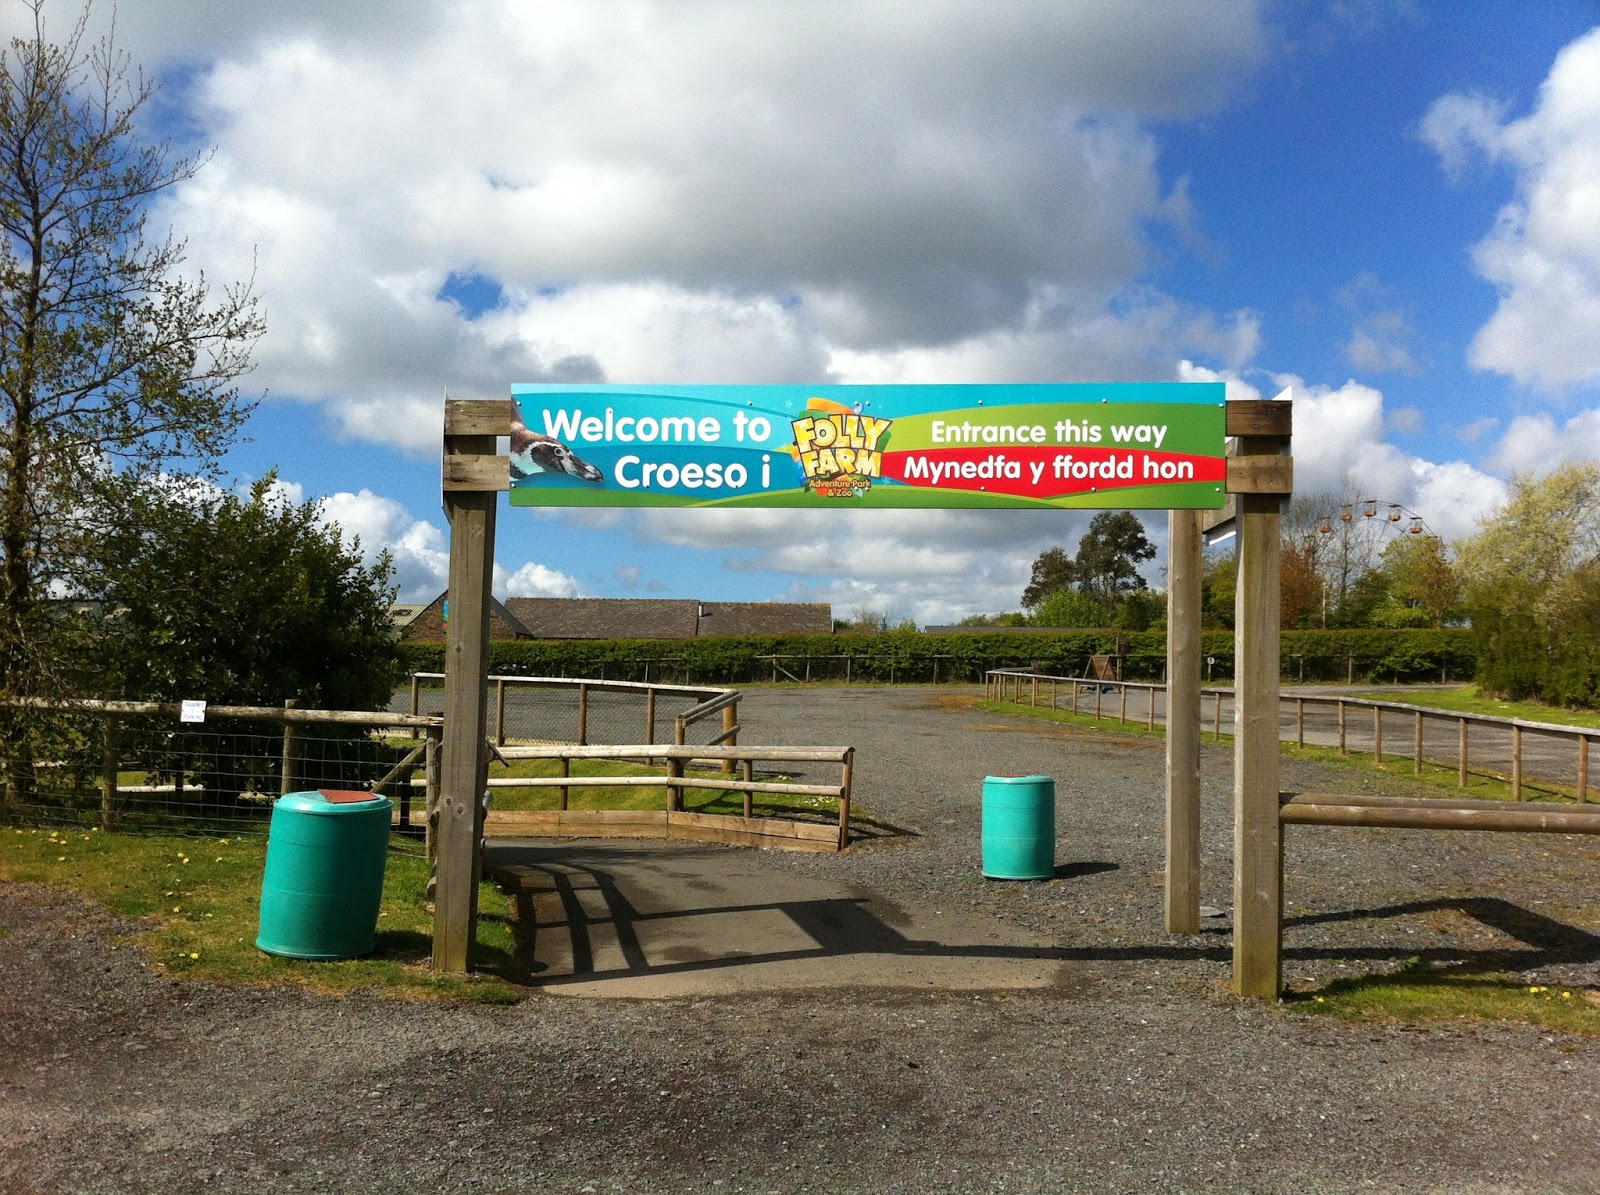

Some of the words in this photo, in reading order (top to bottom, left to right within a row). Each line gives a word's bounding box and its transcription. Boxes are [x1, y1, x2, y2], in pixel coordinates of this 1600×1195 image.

[542, 407, 721, 442] Welcome
[732, 410, 772, 442] to
[791, 413, 893, 453] FOLLY
[931, 420, 1047, 443] Entrance
[1054, 418, 1102, 443] this
[1110, 425, 1168, 449] way
[614, 455, 748, 489] Croeso
[762, 454, 771, 488] i
[800, 447, 883, 478] FARM
[903, 454, 1021, 485] Mynedfa
[1029, 461, 1045, 485] y
[1052, 454, 1134, 479] ffordd
[1143, 454, 1194, 479] hon
[809, 480, 851, 488] Adventure
[852, 480, 871, 488] Park
[836, 489, 853, 497] Zoo
